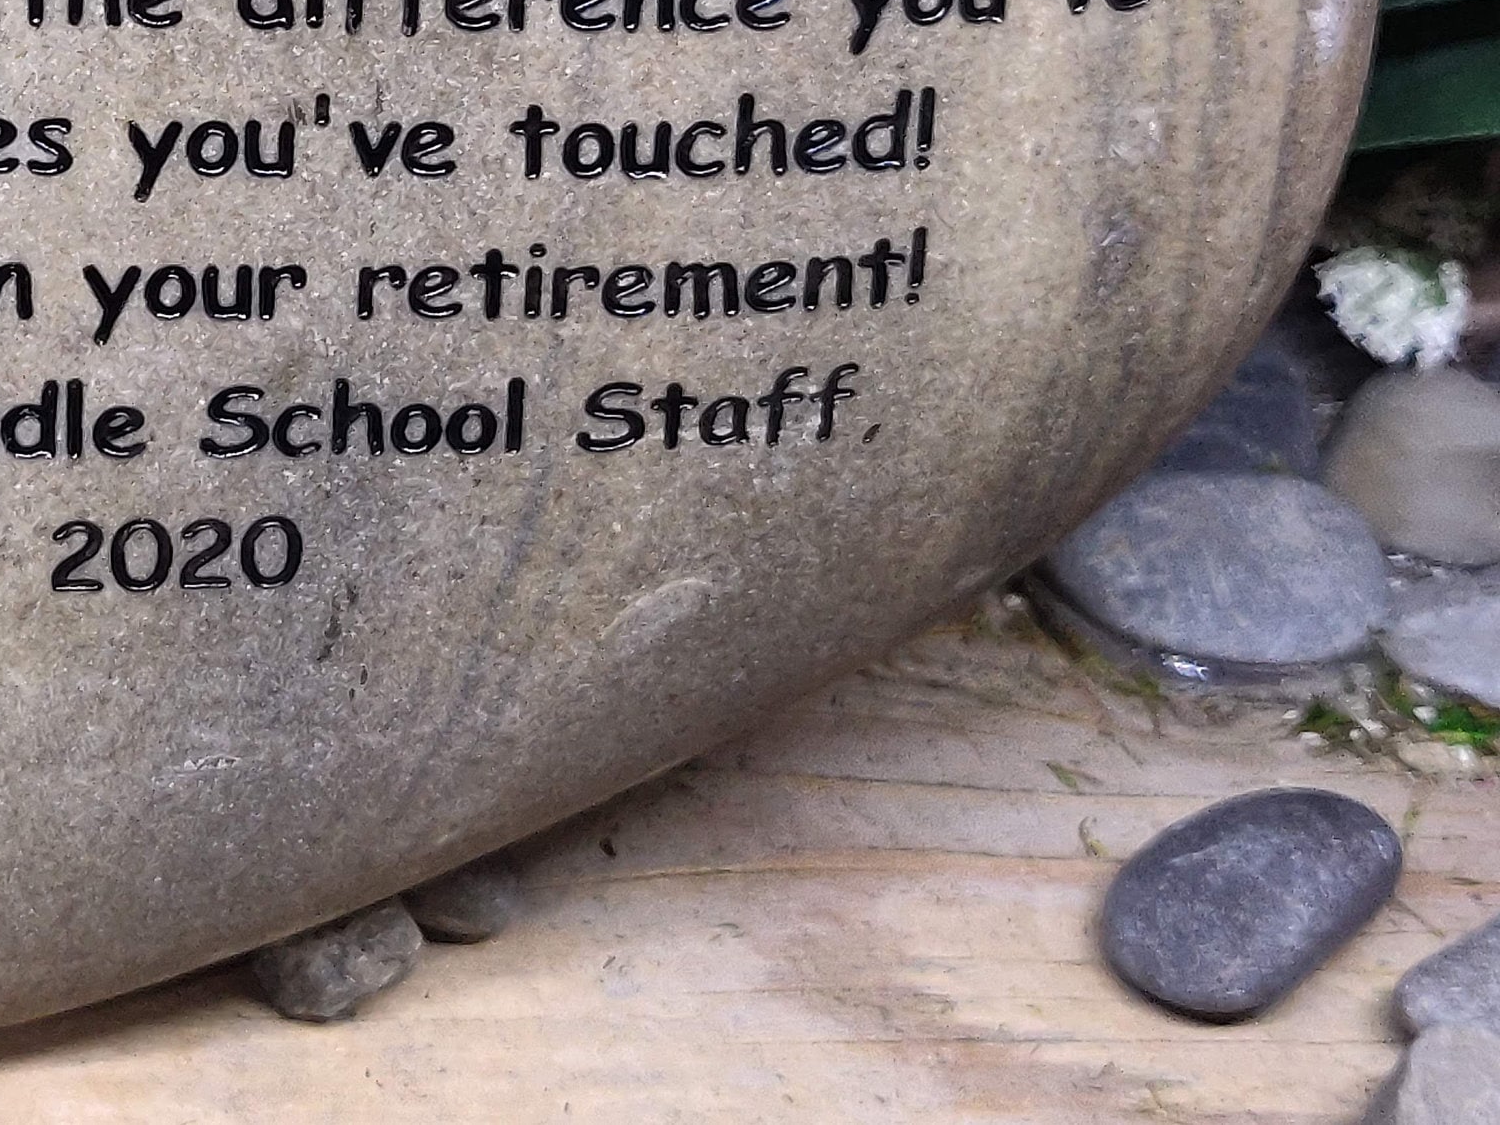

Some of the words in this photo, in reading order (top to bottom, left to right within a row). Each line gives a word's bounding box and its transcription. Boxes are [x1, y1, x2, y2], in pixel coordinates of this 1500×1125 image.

[128, 93, 457, 200] you've
[509, 87, 936, 180] touched!
[83, 264, 307, 345] your
[357, 226, 927, 321] retirement!
[199, 377, 526, 458] School
[51, 515, 304, 593] 2020
